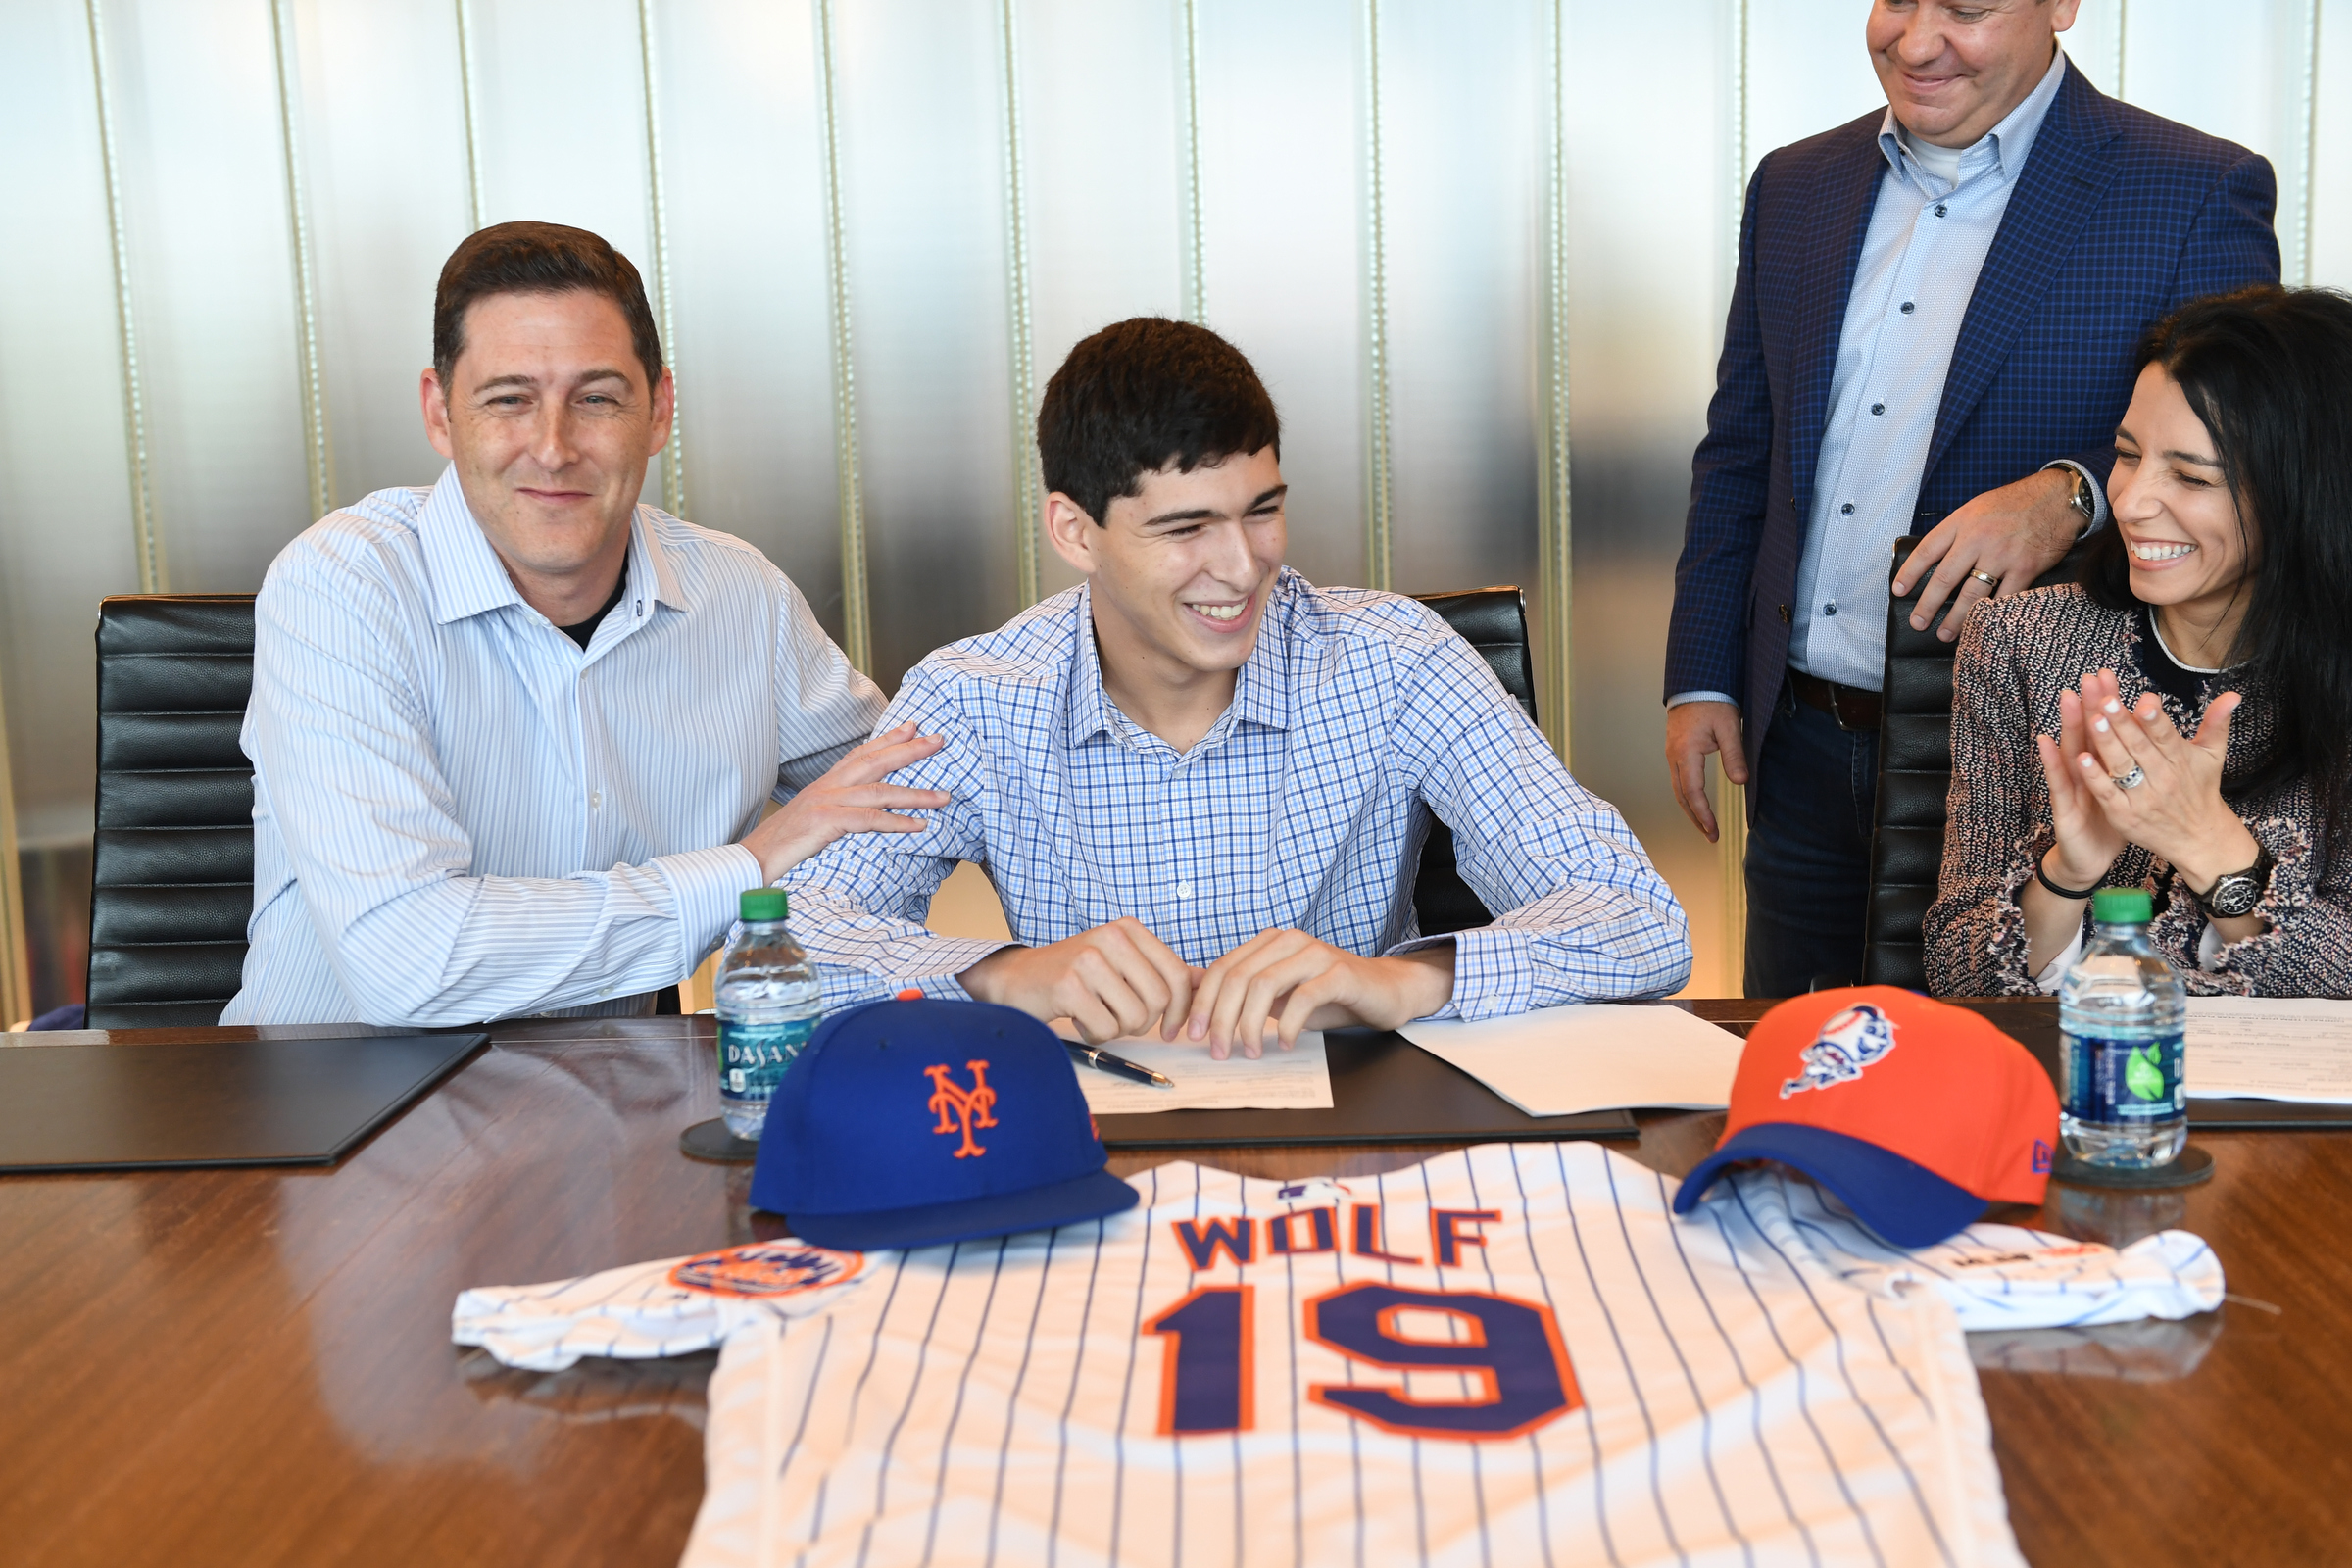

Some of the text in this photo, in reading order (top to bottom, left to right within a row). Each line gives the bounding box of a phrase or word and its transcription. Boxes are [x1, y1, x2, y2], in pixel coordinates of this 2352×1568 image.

[728, 1038, 807, 1069] DASAN
[923, 1060, 998, 1158] NY
[1171, 1203, 1502, 1272] WOLF
[1141, 1279, 1586, 1442] 19
